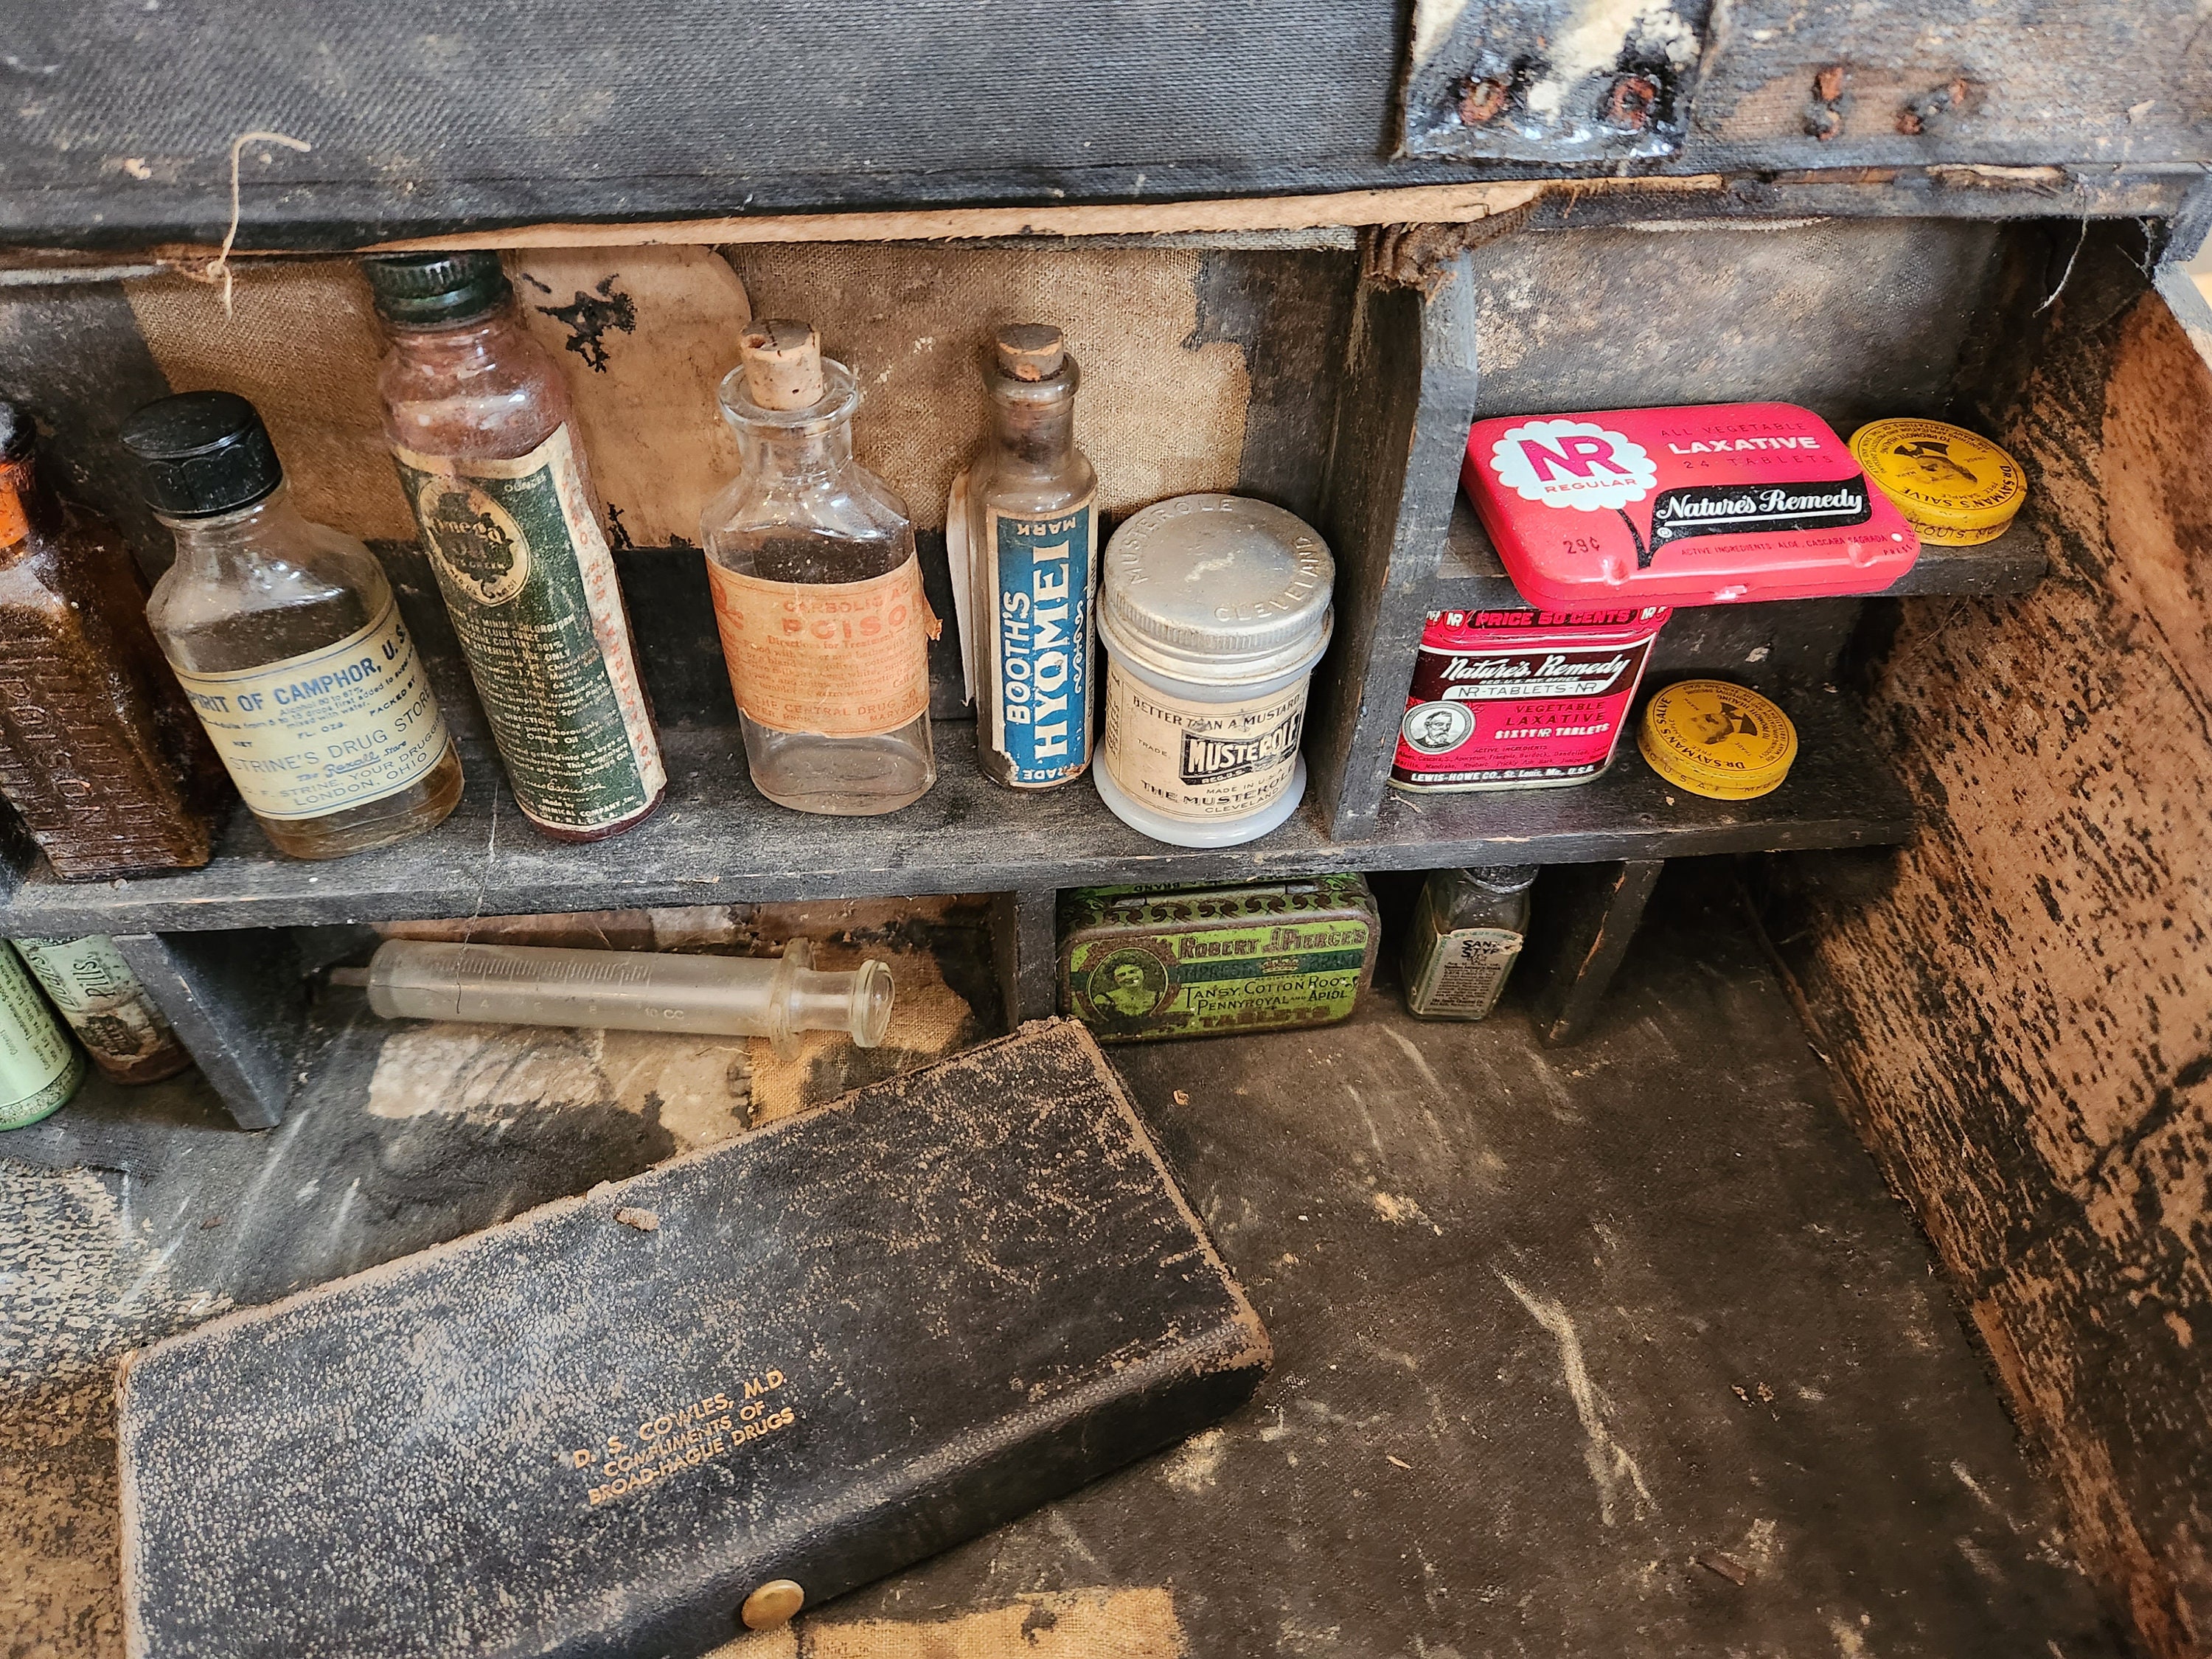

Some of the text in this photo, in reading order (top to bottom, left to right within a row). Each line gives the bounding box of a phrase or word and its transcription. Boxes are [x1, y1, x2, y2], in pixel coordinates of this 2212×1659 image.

[1661, 422, 1806, 437] ALL VEGETABLE
[1902, 432, 1938, 442] PROMOTE
[1938, 435, 1951, 443] TO
[1668, 436, 1820, 455] LAXATIVE
[1517, 435, 1633, 482] NR
[1731, 455, 1834, 467] TABLETS
[1545, 479, 1638, 493] REGULAR
[1960, 481, 2015, 509] SAYMAN'S
[1656, 488, 1863, 519] Nature's Remedy
[1900, 487, 1952, 507] SALVE
[1017, 515, 1077, 537] MARK
[1130, 498, 1235, 585] MUSTEROLE
[1563, 537, 1600, 554] 29¢
[1681, 548, 1711, 557] ACTIVE
[1214, 535, 1321, 622] CLEVELAND
[1446, 611, 1463, 627] NR
[1475, 611, 1532, 627] PRICE
[1538, 611, 1566, 625] 50
[1570, 609, 1631, 625] CENTS
[483, 628, 509, 638] FLUID
[823, 641, 839, 650] for
[844, 630, 895, 650] Treatment
[544, 647, 571, 662] ONLY
[1002, 591, 1031, 724] BOOTH'S
[1033, 540, 1069, 759] HYOMEI
[1441, 654, 1632, 681] Nature's Remedy
[184, 687, 229, 713] PIRIT
[237, 692, 263, 712] OF
[274, 656, 382, 706] CAMPHOR,
[358, 684, 384, 702] added
[386, 676, 394, 686] to
[369, 687, 407, 717] PACKED
[753, 694, 779, 711] THE
[858, 700, 896, 717] DRUG
[1515, 701, 1606, 714] VEGETABLE
[1656, 696, 1672, 726] SALVE
[1717, 694, 1750, 709] HEALING
[1133, 695, 1183, 726] BETTER
[1228, 720, 1238, 730] A
[1244, 695, 1301, 725] MUSTARD
[1505, 712, 1606, 727] LAXATIVE
[550, 720, 600, 737] thoroughly
[1555, 723, 1610, 737] TABLETS
[526, 733, 579, 745] Omega Oil
[1137, 738, 1168, 757] TRADE
[1188, 711, 1298, 773] MUSTEROLE
[1660, 728, 1726, 769] SAYMAN'S
[229, 751, 319, 773] STRINE'S
[327, 728, 388, 759] DRUG
[582, 751, 597, 759] the
[349, 760, 395, 781] YOUR
[566, 762, 586, 770] This
[584, 759, 616, 776] Omega
[294, 751, 428, 806] LONDON, OHIO
[1141, 766, 1294, 805] THE MUSTEROLE
[1411, 771, 1479, 782] LEWIS-HOWE
[1205, 787, 1281, 813] CLEVELAND
[1206, 786, 1238, 794] MADE
[1178, 936, 1261, 959] ROBERT
[1280, 928, 1368, 951] PIERCE'S
[1461, 946, 1500, 958] STYP
[1244, 980, 1305, 995] COTTON
[1196, 995, 1290, 1016] PENNYROYAL
[1309, 989, 1349, 1002] APIOL
[664, 1009, 684, 1020] CC
[573, 1448, 597, 1469] D.
[607, 1436, 627, 1454] S.
[639, 1392, 734, 1441] COWLES,
[603, 1401, 765, 1477] COMPLIMENTS OF
[588, 1406, 796, 1506] BROAD-HAGUE DRUGS
